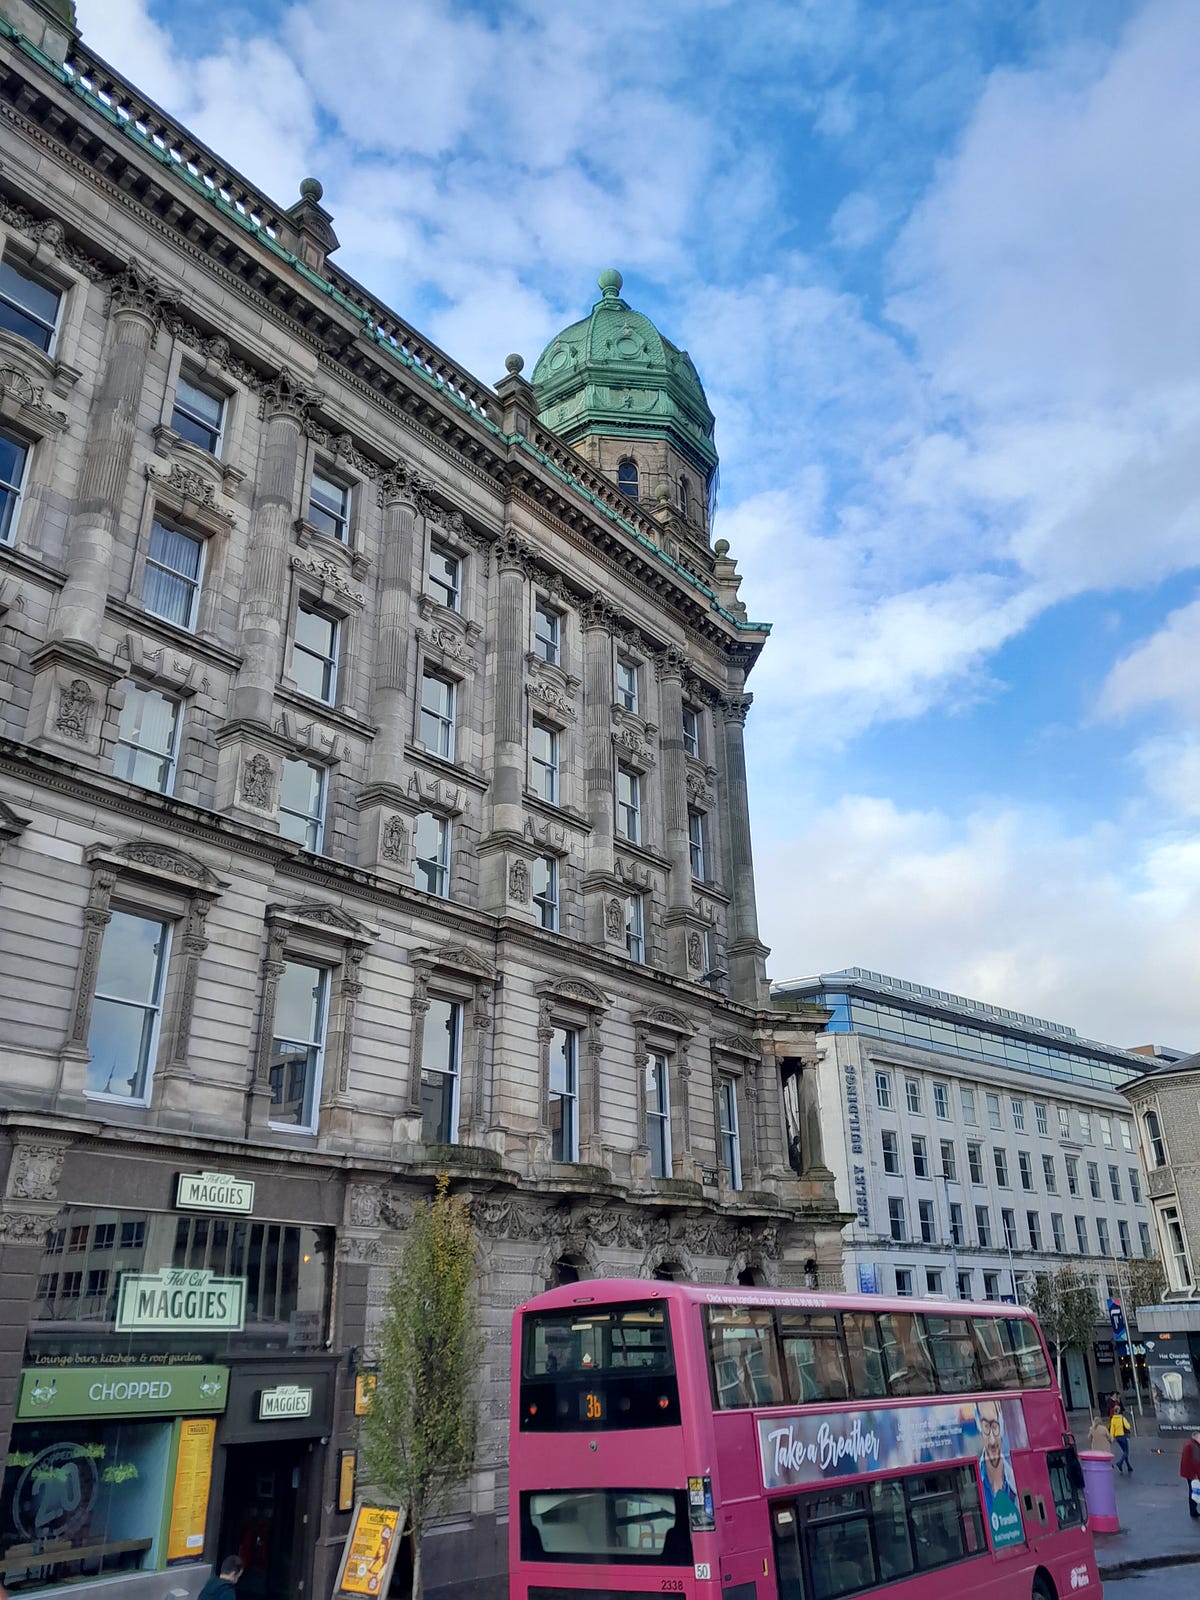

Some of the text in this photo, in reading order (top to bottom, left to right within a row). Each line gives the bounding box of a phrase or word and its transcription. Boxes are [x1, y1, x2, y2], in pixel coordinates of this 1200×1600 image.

[844, 1065, 869, 1228] LESLEY BUILDINGS
[189, 1184, 243, 1205] MAGGIES
[163, 1270, 187, 1286] Hell
[138, 1289, 227, 1319] MAGGIES
[35, 1353, 72, 1366] Lounge
[100, 1352, 136, 1364] kitchen
[139, 1353, 147, 1362] &
[89, 1381, 172, 1401] CHOPPED
[265, 1397, 306, 1413] MAGGIES
[586, 1394, 601, 1418] 3b
[768, 1419, 880, 1476] Take a Breather
[697, 1565, 708, 1578] 50
[661, 1580, 683, 1591] 2338
